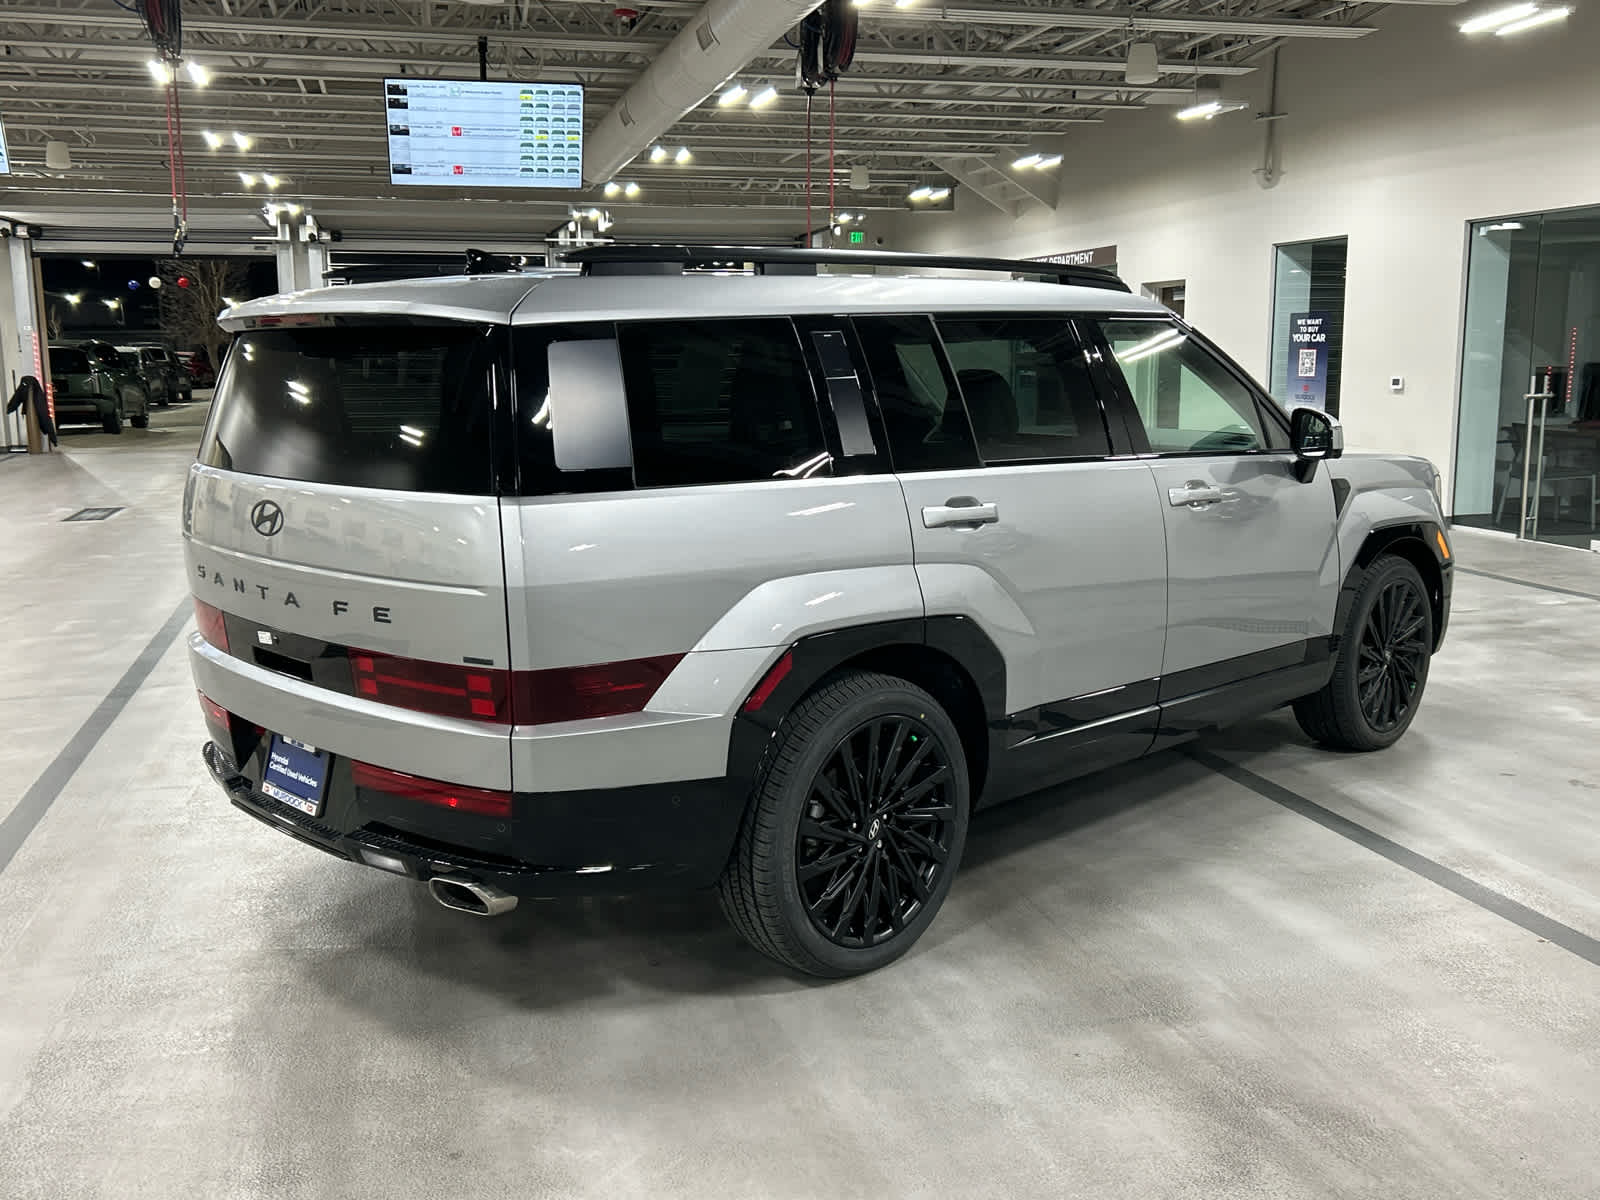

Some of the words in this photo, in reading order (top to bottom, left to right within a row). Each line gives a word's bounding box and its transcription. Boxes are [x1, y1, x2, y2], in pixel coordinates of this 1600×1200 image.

[851, 232, 863, 243] EXIT
[1049, 251, 1094, 264] DEPARTMENT
[1292, 334, 1310, 342] YOUR
[1311, 334, 1326, 342] CAR
[197, 565, 301, 609] SANTA
[333, 600, 392, 624] FE
[271, 752, 289, 765] Hyundai
